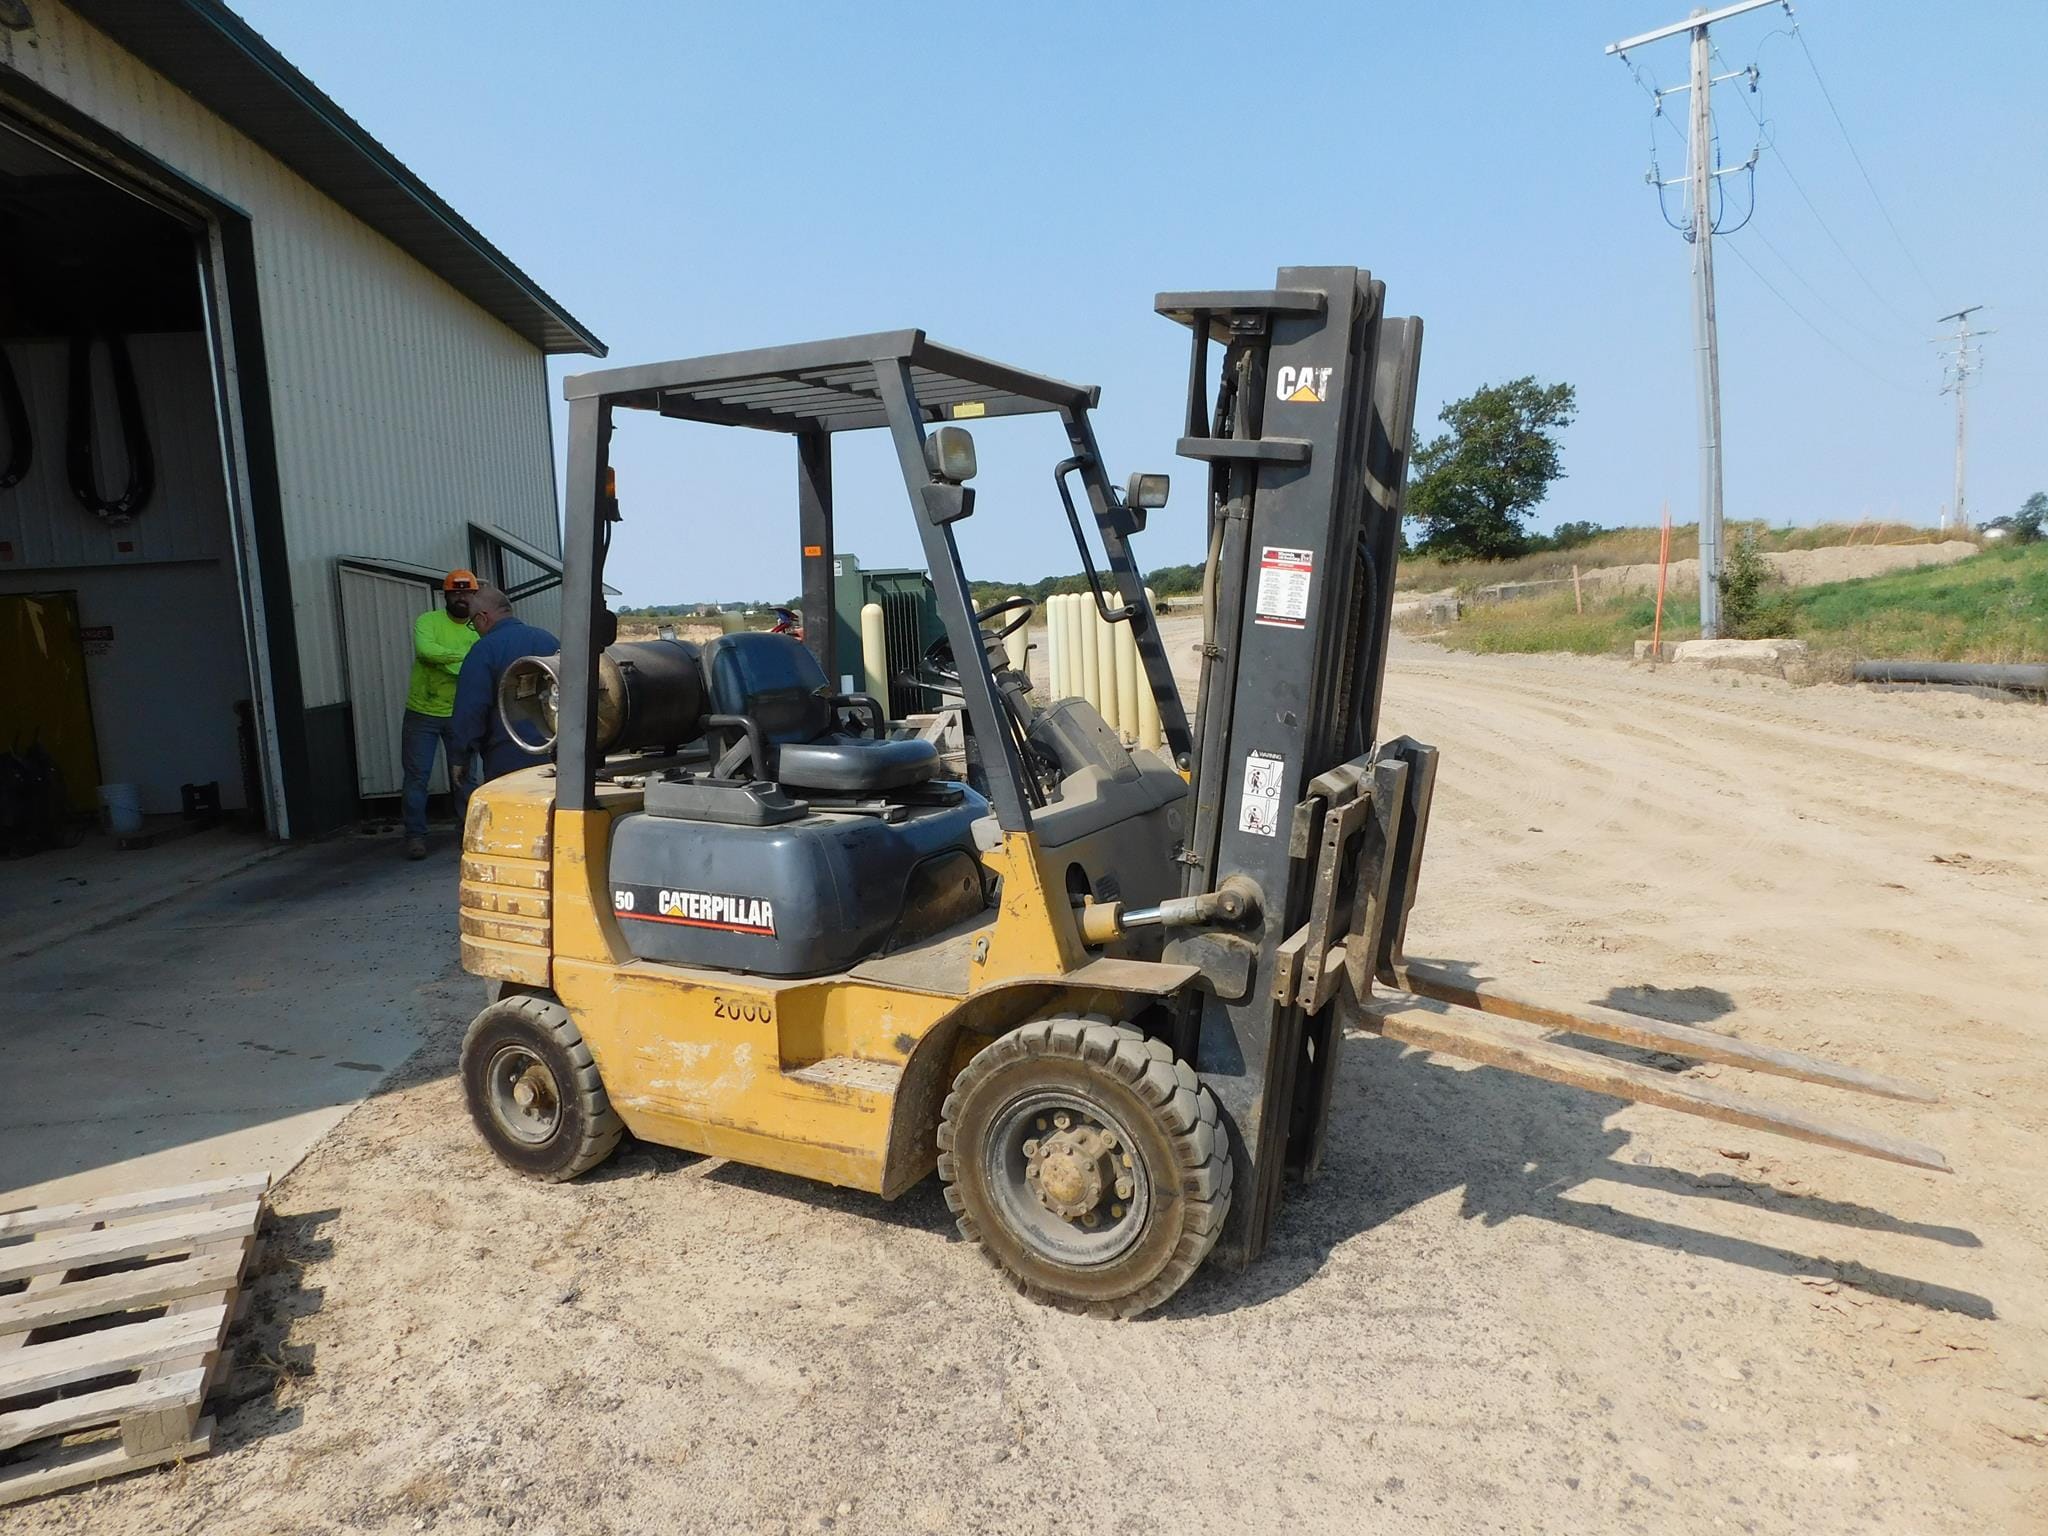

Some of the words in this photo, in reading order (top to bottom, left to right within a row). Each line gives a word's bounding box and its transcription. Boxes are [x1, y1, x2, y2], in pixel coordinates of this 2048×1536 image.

[1276, 365, 1333, 402] CAT
[615, 890, 635, 911] 50
[658, 889, 773, 927] CATERPILLAR
[714, 996, 771, 1024] 2000
